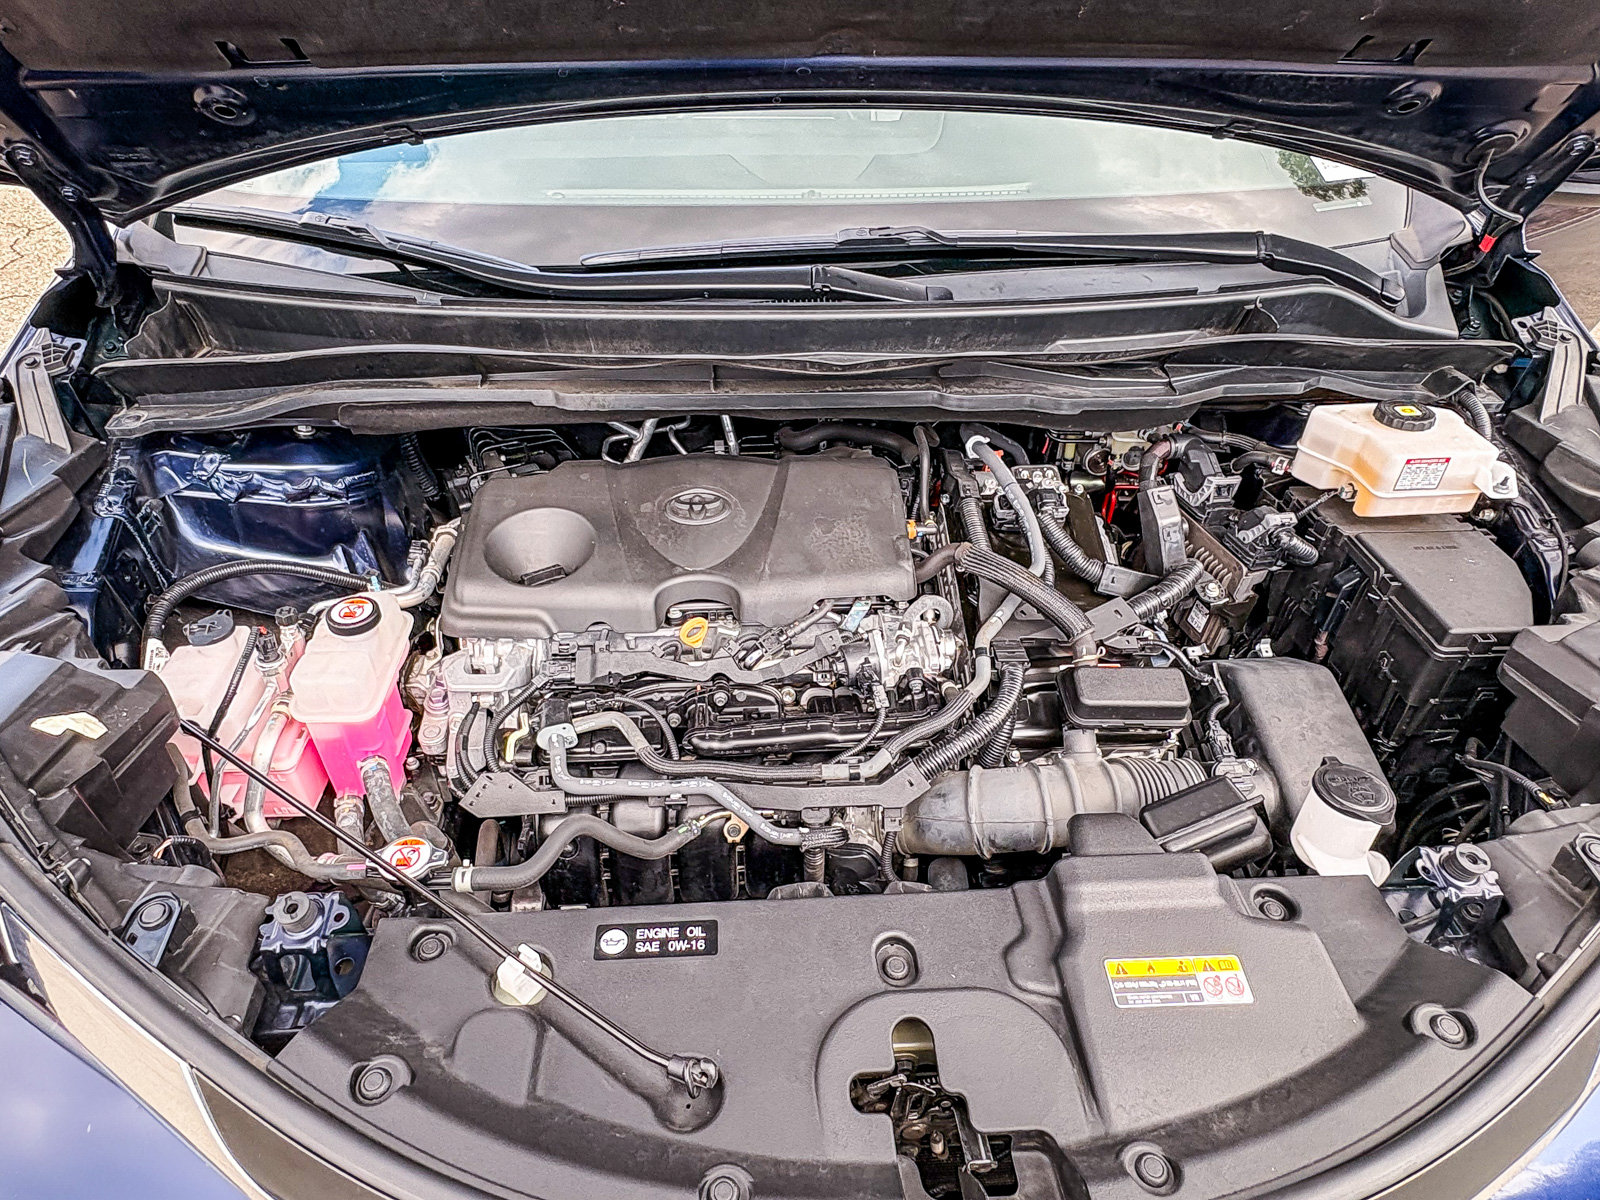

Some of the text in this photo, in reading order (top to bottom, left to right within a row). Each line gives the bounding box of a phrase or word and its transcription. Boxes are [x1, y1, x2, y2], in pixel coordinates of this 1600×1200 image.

[636, 926, 706, 939] ENGINE OIL
[635, 939, 705, 952] SAE 0W-16
